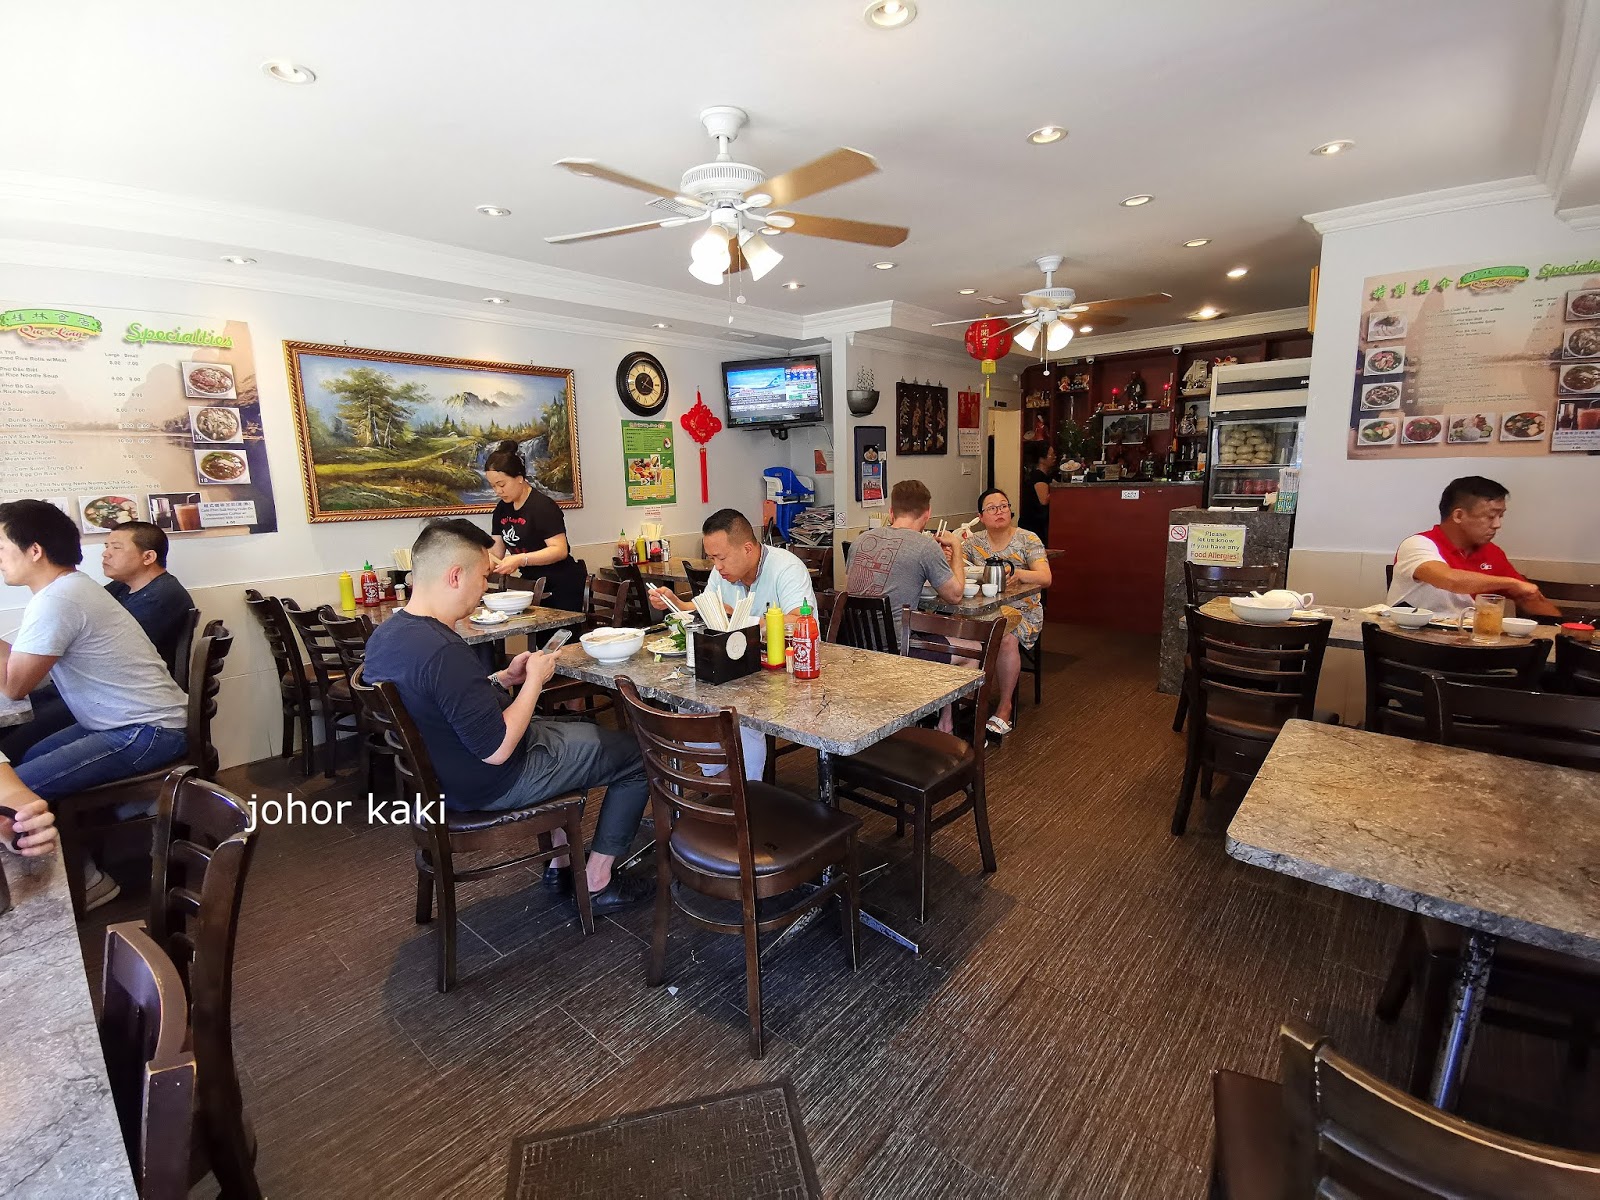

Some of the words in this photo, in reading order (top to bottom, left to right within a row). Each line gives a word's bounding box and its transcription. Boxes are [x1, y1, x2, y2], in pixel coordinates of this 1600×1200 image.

[125, 322, 234, 348] Specialties
[1205, 530, 1228, 538] Please
[1227, 544, 1241, 552] any
[1190, 550, 1207, 558] Food
